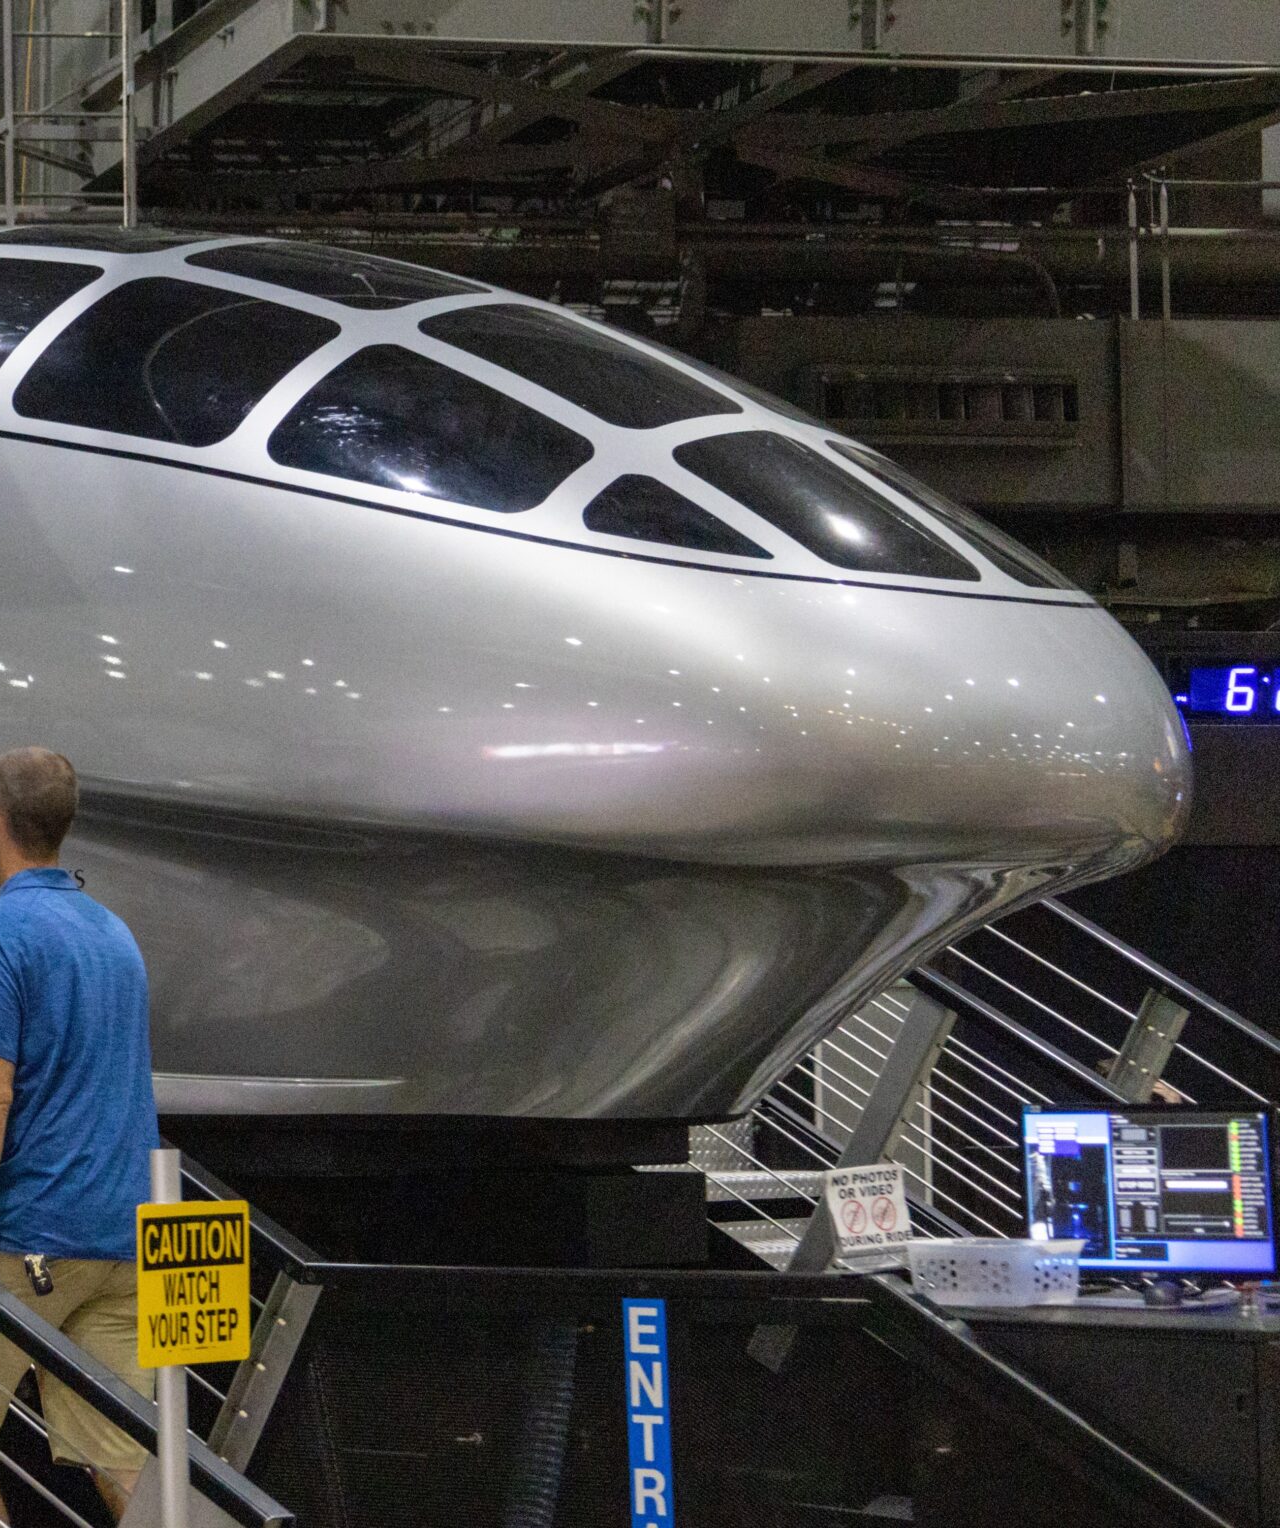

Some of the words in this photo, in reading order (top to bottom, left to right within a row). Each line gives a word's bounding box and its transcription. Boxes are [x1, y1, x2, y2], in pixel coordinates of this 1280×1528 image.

[831, 1175, 849, 1187] NO
[852, 1170, 898, 1185] PHOTOS
[839, 1188, 856, 1200] OR
[859, 1184, 894, 1198] VIDEO
[144, 1220, 242, 1265] CAUTION
[840, 1233, 883, 1248] DURING
[886, 1230, 914, 1242] RIDE
[163, 1270, 220, 1306] WATCH
[148, 1311, 190, 1349] YOUR
[195, 1307, 238, 1344] STEP
[628, 1307, 667, 1528] ENTR
